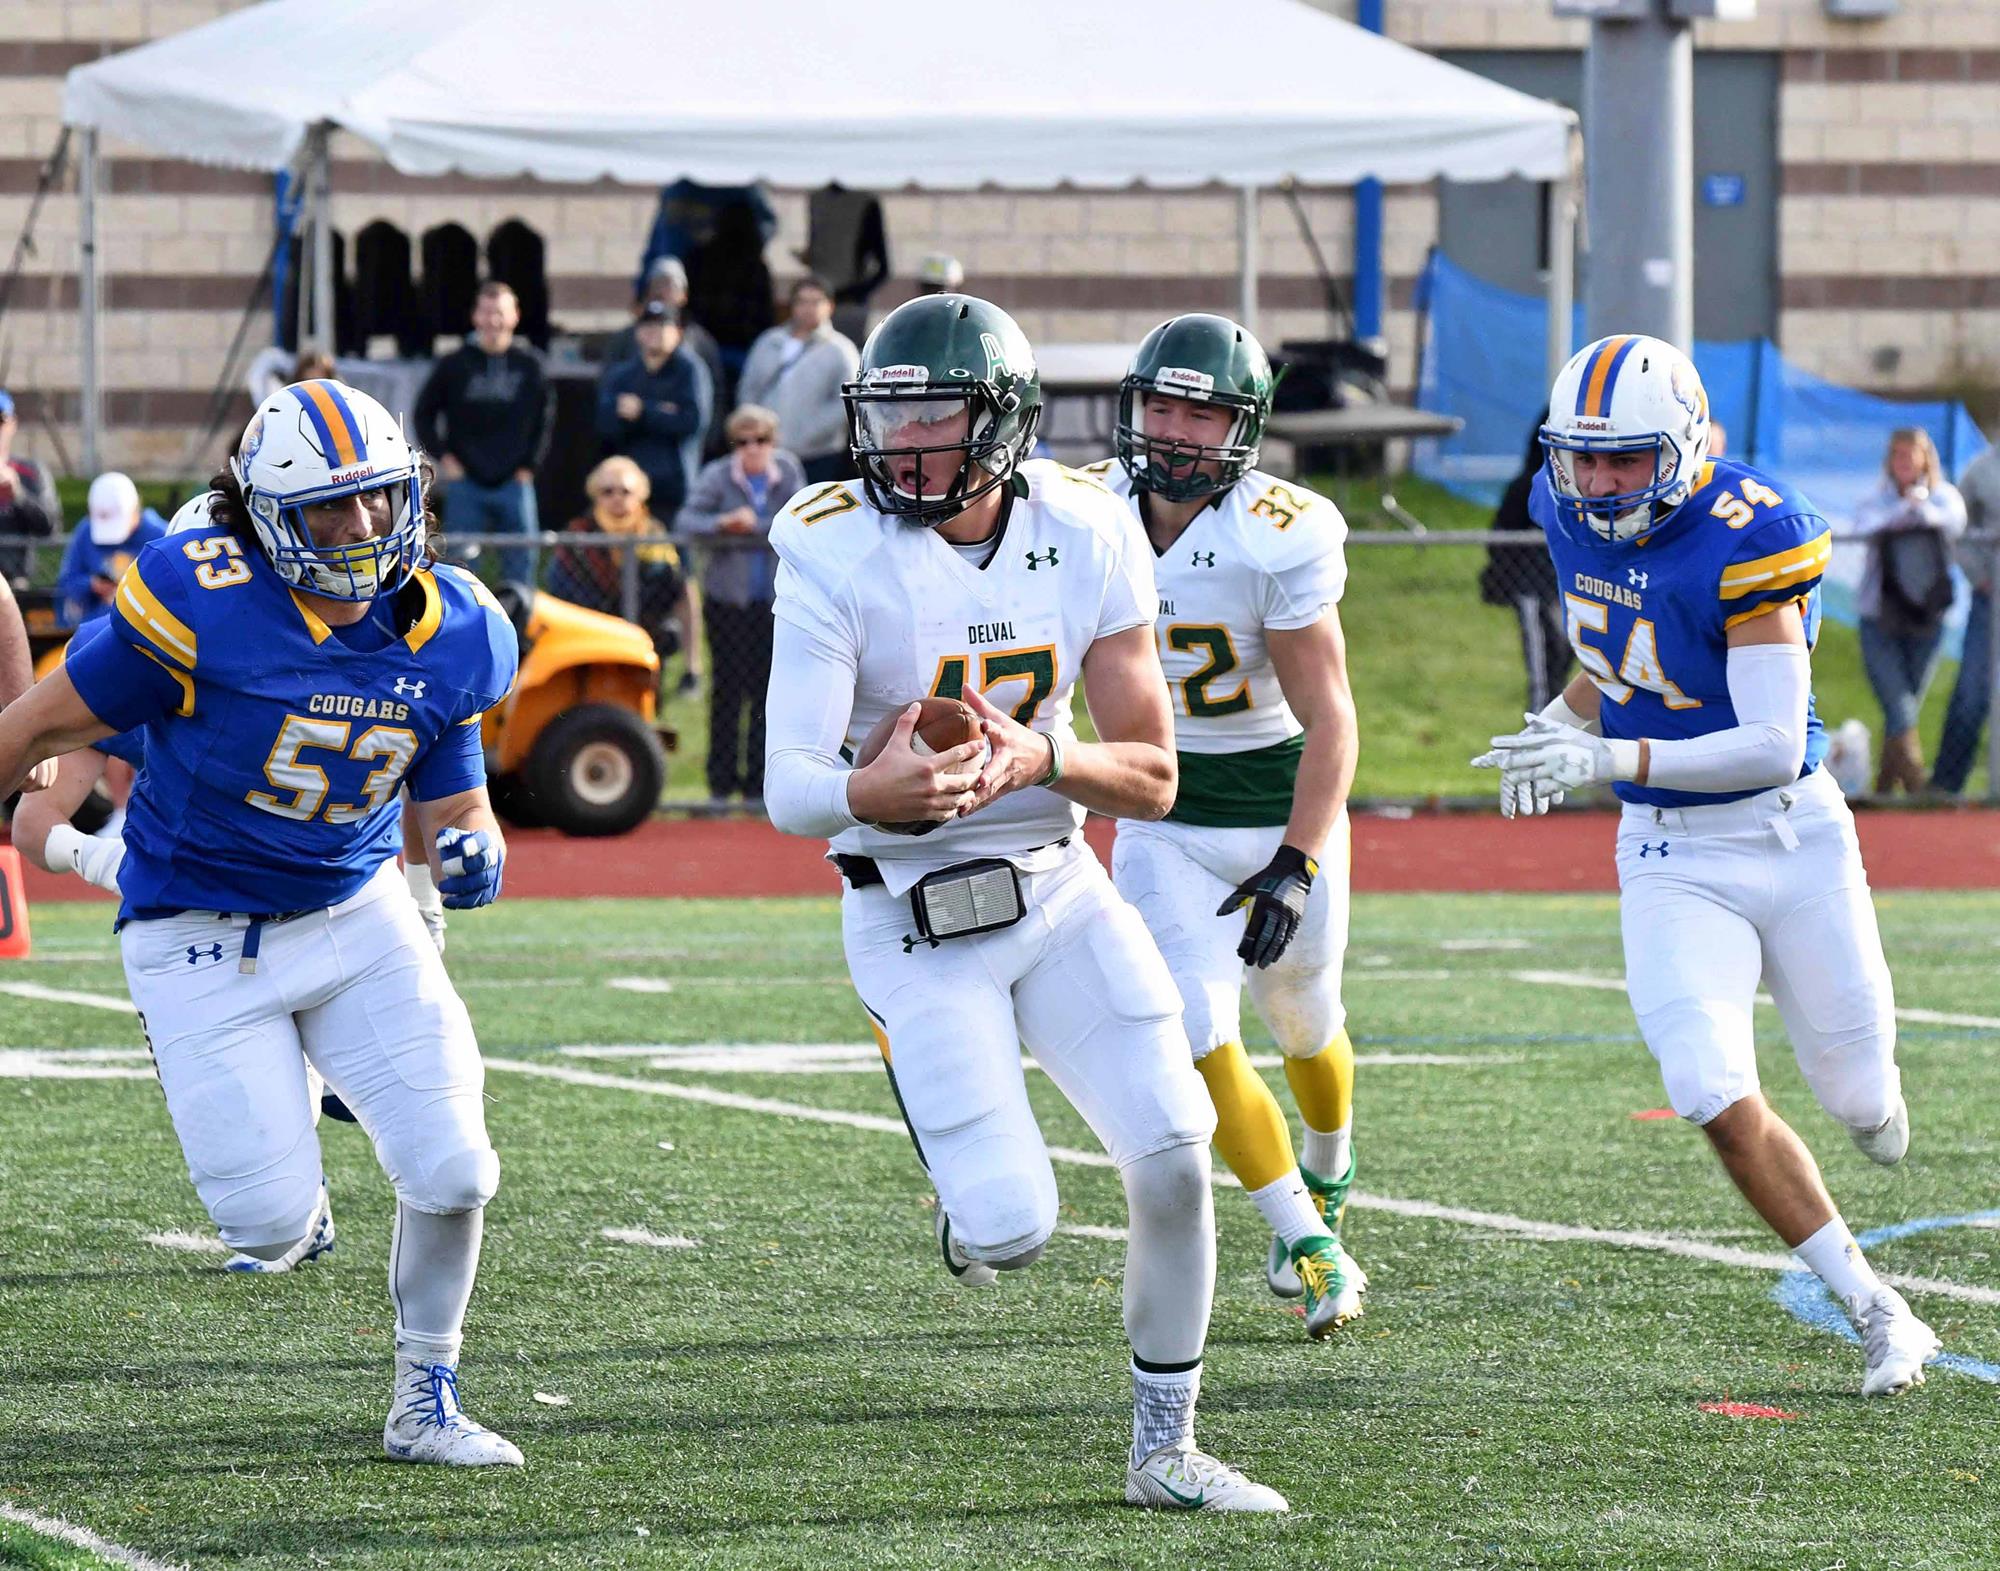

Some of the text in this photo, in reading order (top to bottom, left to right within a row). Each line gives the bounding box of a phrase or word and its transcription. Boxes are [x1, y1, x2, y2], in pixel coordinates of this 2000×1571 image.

[882, 368, 915, 380] Riddell
[1171, 370, 1202, 383] Riddell
[1577, 422, 1607, 432] Riddell
[331, 466, 374, 485] Riddell
[790, 483, 862, 527] 17
[1248, 485, 1311, 532] 32
[1710, 478, 1783, 529] 54
[183, 536, 253, 590] 53
[1159, 600, 1176, 616] VAL
[1575, 573, 1642, 611] COUGARS
[968, 621, 1016, 645] DELVAL
[1565, 592, 1703, 710] 54
[928, 643, 1059, 729] 17
[1157, 624, 1254, 717] 2
[309, 694, 409, 721] COUGARS
[244, 714, 419, 824] 53
